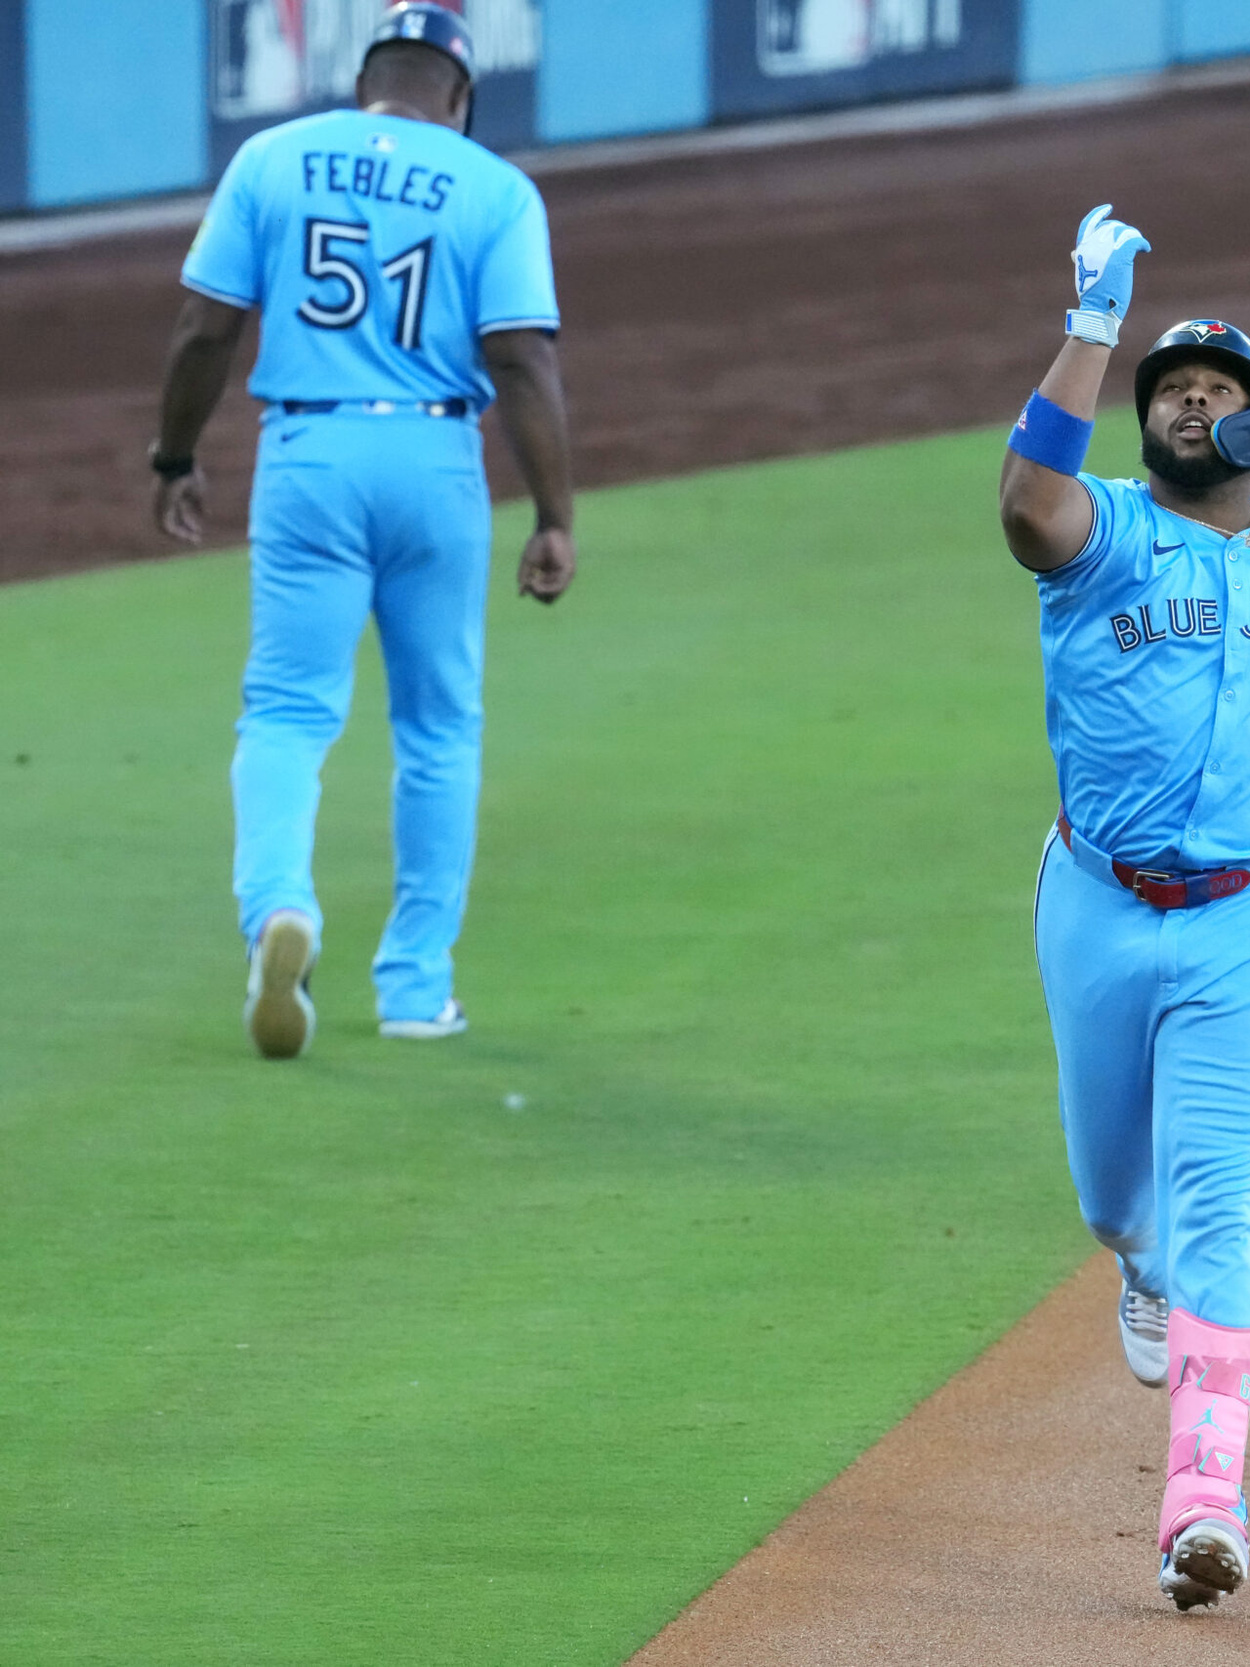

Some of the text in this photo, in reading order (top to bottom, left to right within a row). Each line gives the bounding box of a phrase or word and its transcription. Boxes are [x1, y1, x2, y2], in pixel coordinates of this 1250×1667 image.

[303, 151, 454, 212] FEBLES
[296, 218, 434, 351] 51
[1109, 597, 1222, 654] BLUE
